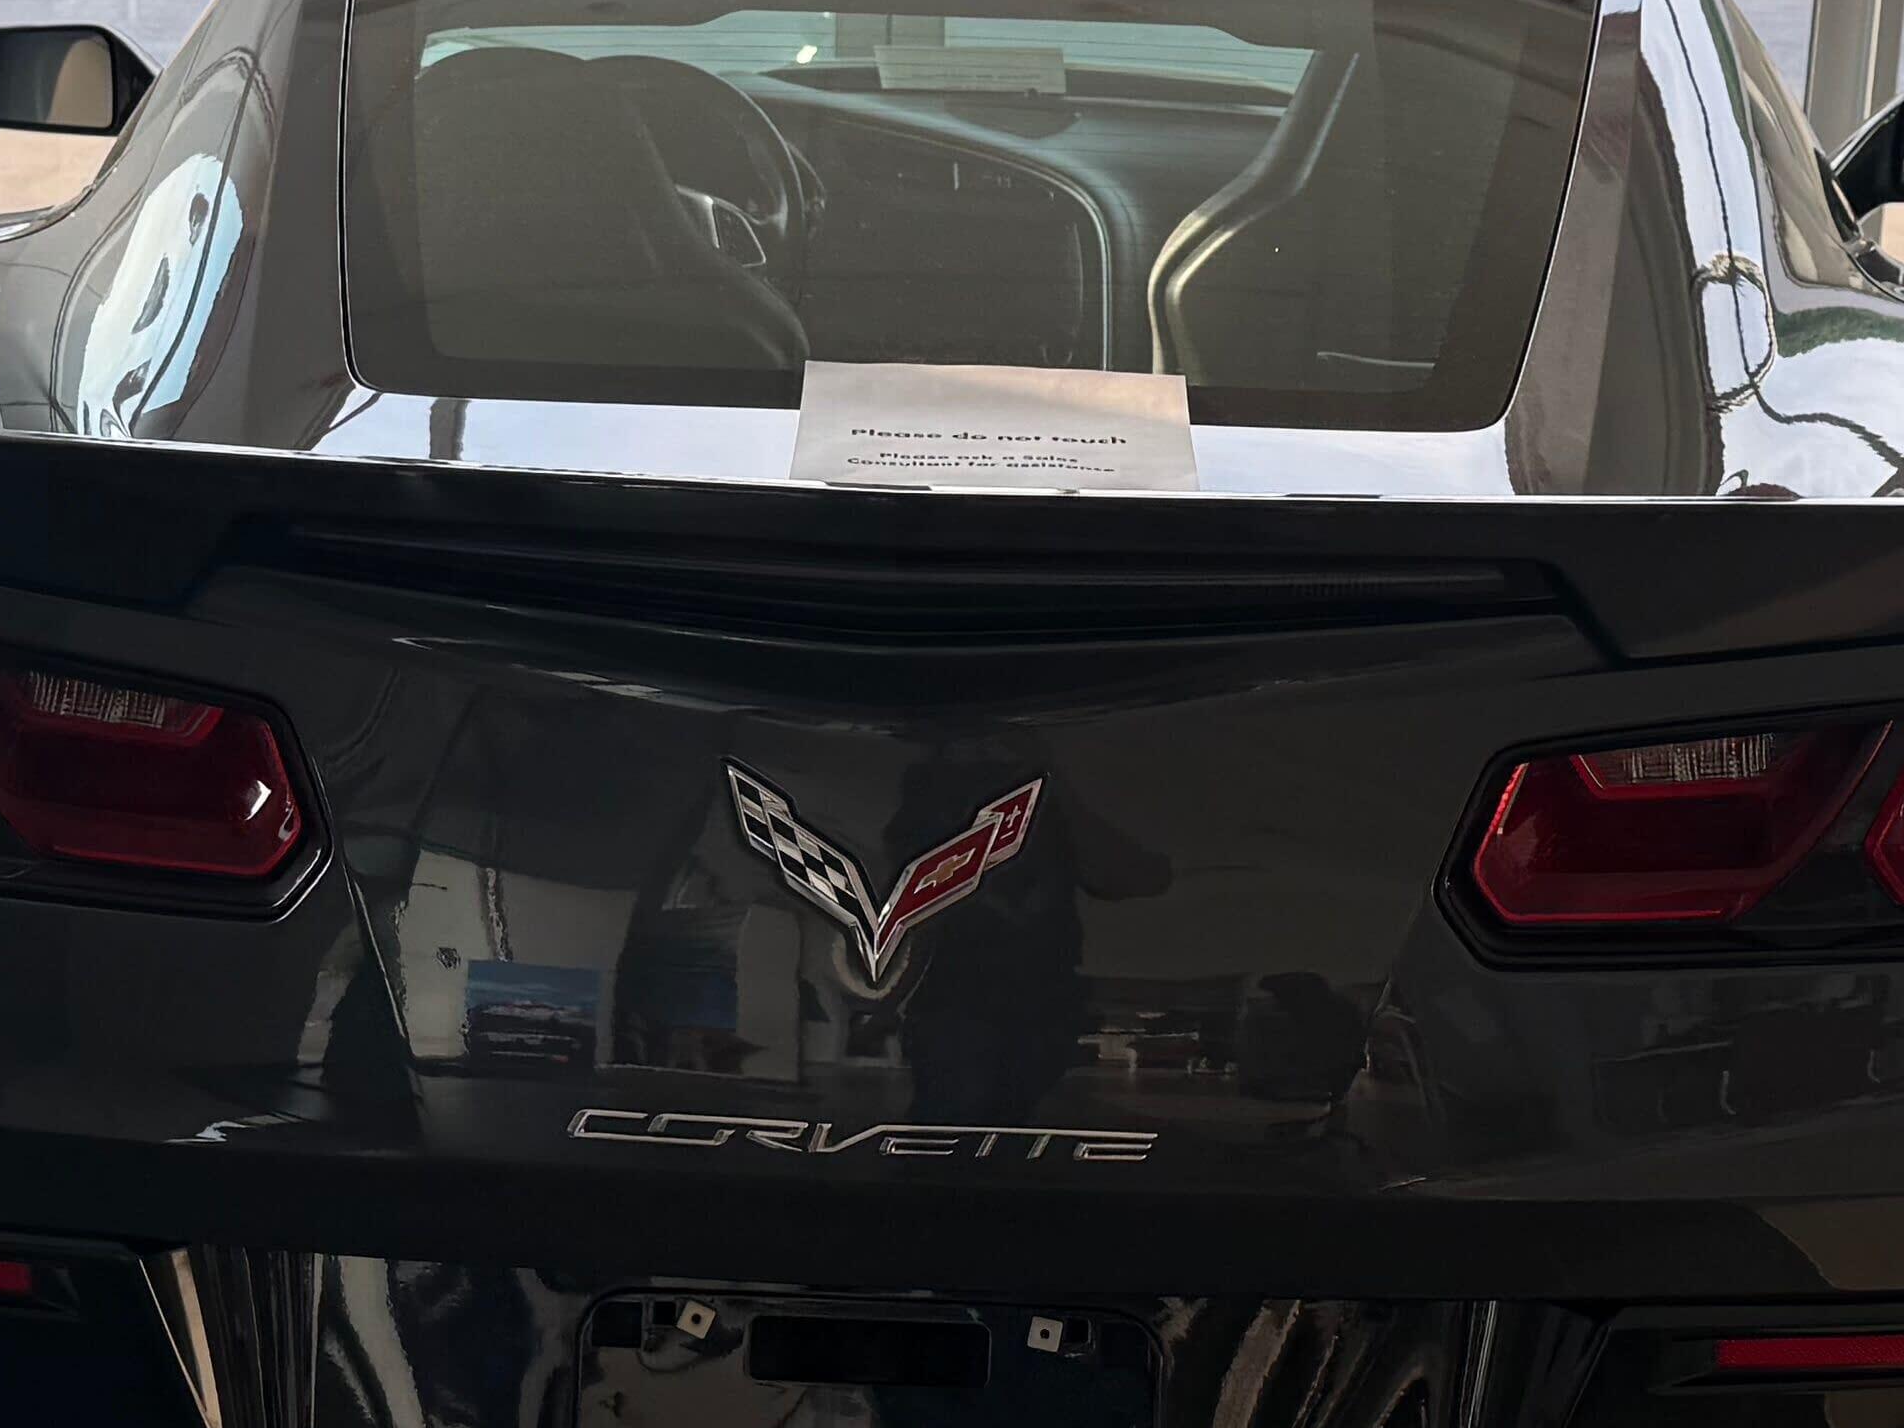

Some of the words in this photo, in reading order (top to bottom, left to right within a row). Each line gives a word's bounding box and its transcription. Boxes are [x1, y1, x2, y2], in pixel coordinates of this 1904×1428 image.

[851, 428, 943, 440] Please
[952, 431, 987, 441] do
[997, 434, 1042, 442] not
[1051, 436, 1127, 445] touch
[847, 457, 960, 467] Consultant
[879, 452, 949, 460] Please
[957, 453, 993, 461] ask
[566, 1108, 1159, 1162] CORVETTE
